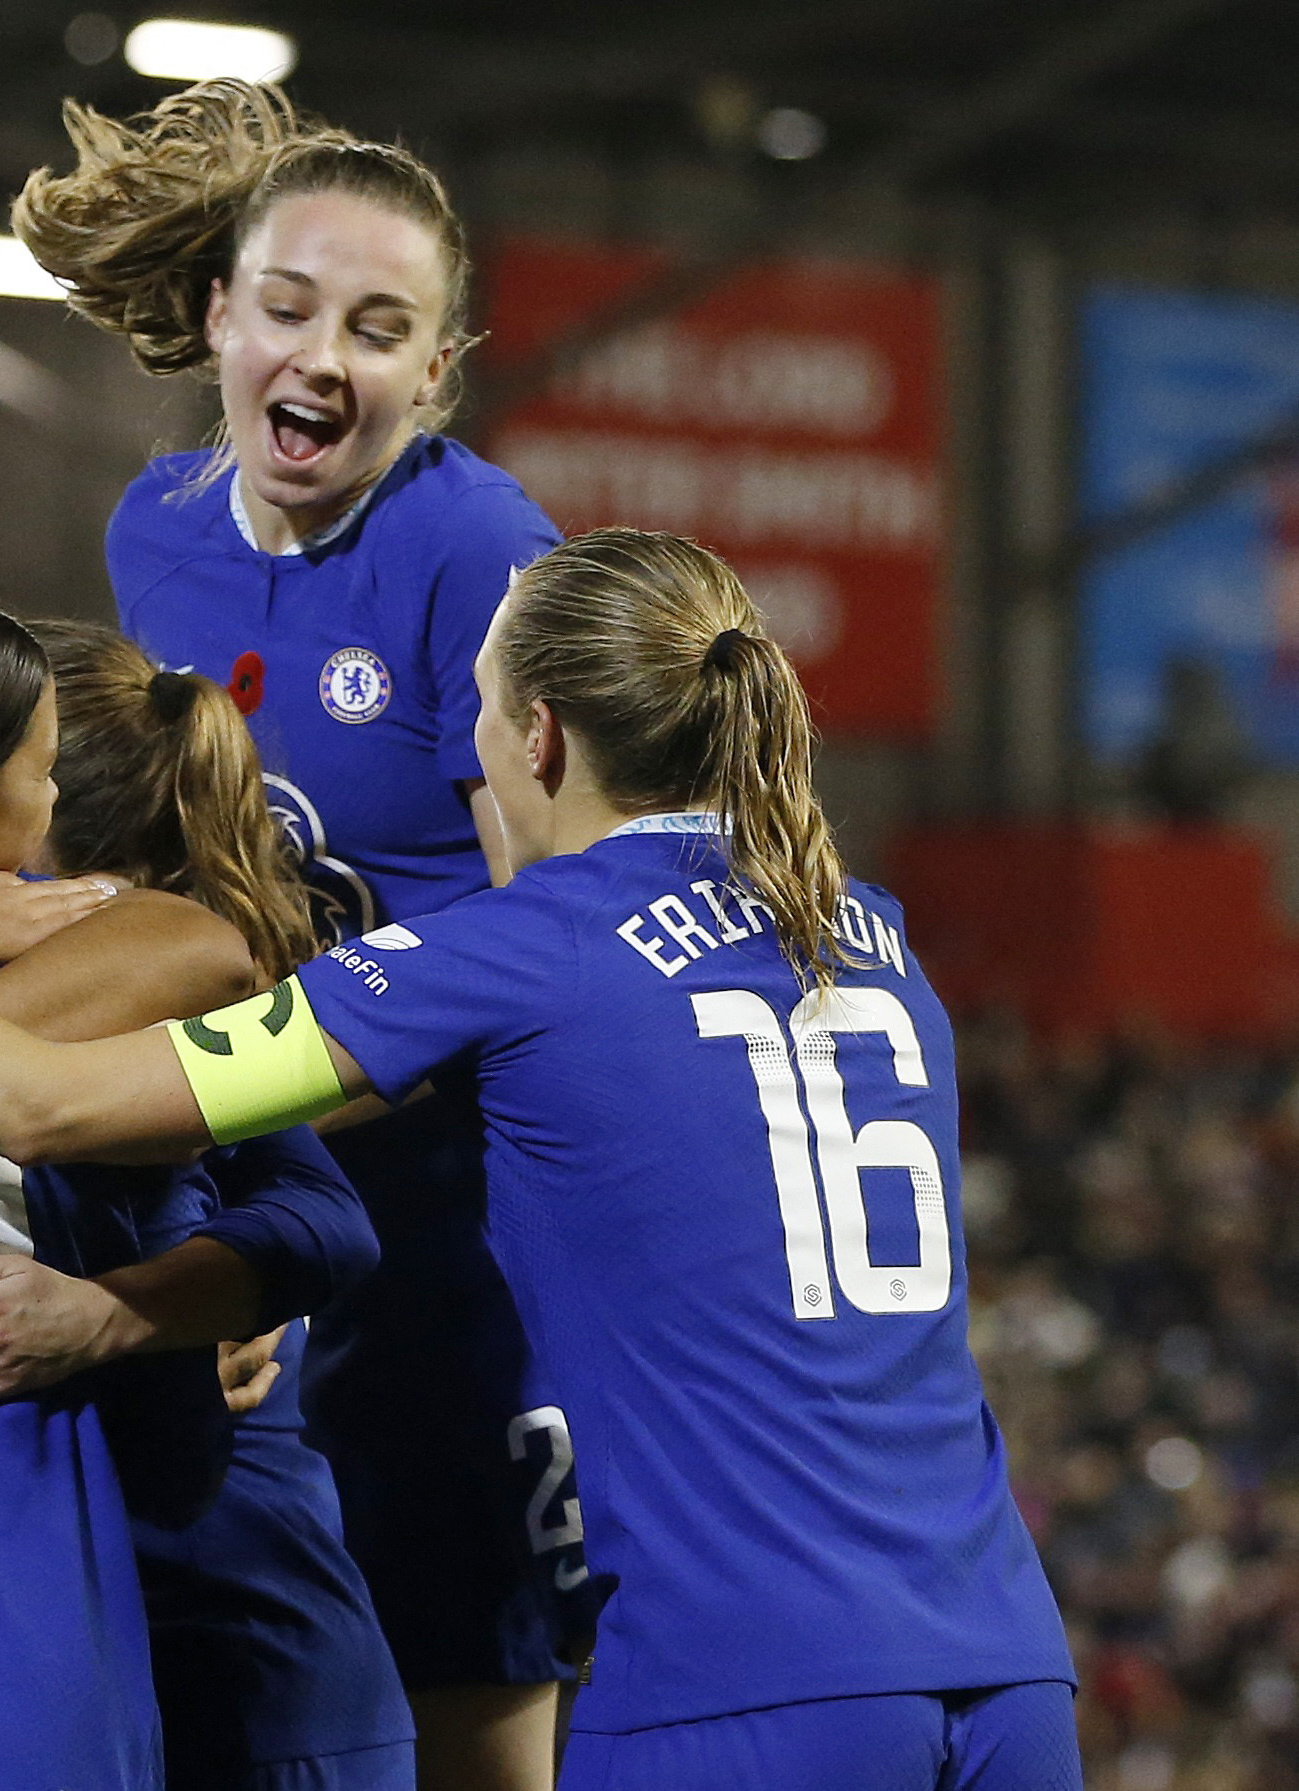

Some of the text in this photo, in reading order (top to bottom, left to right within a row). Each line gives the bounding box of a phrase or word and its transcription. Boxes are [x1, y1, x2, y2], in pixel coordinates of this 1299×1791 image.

[323, 945, 390, 996] aleFin
[615, 879, 907, 979] ERIKON
[689, 986, 952, 1321] 16
